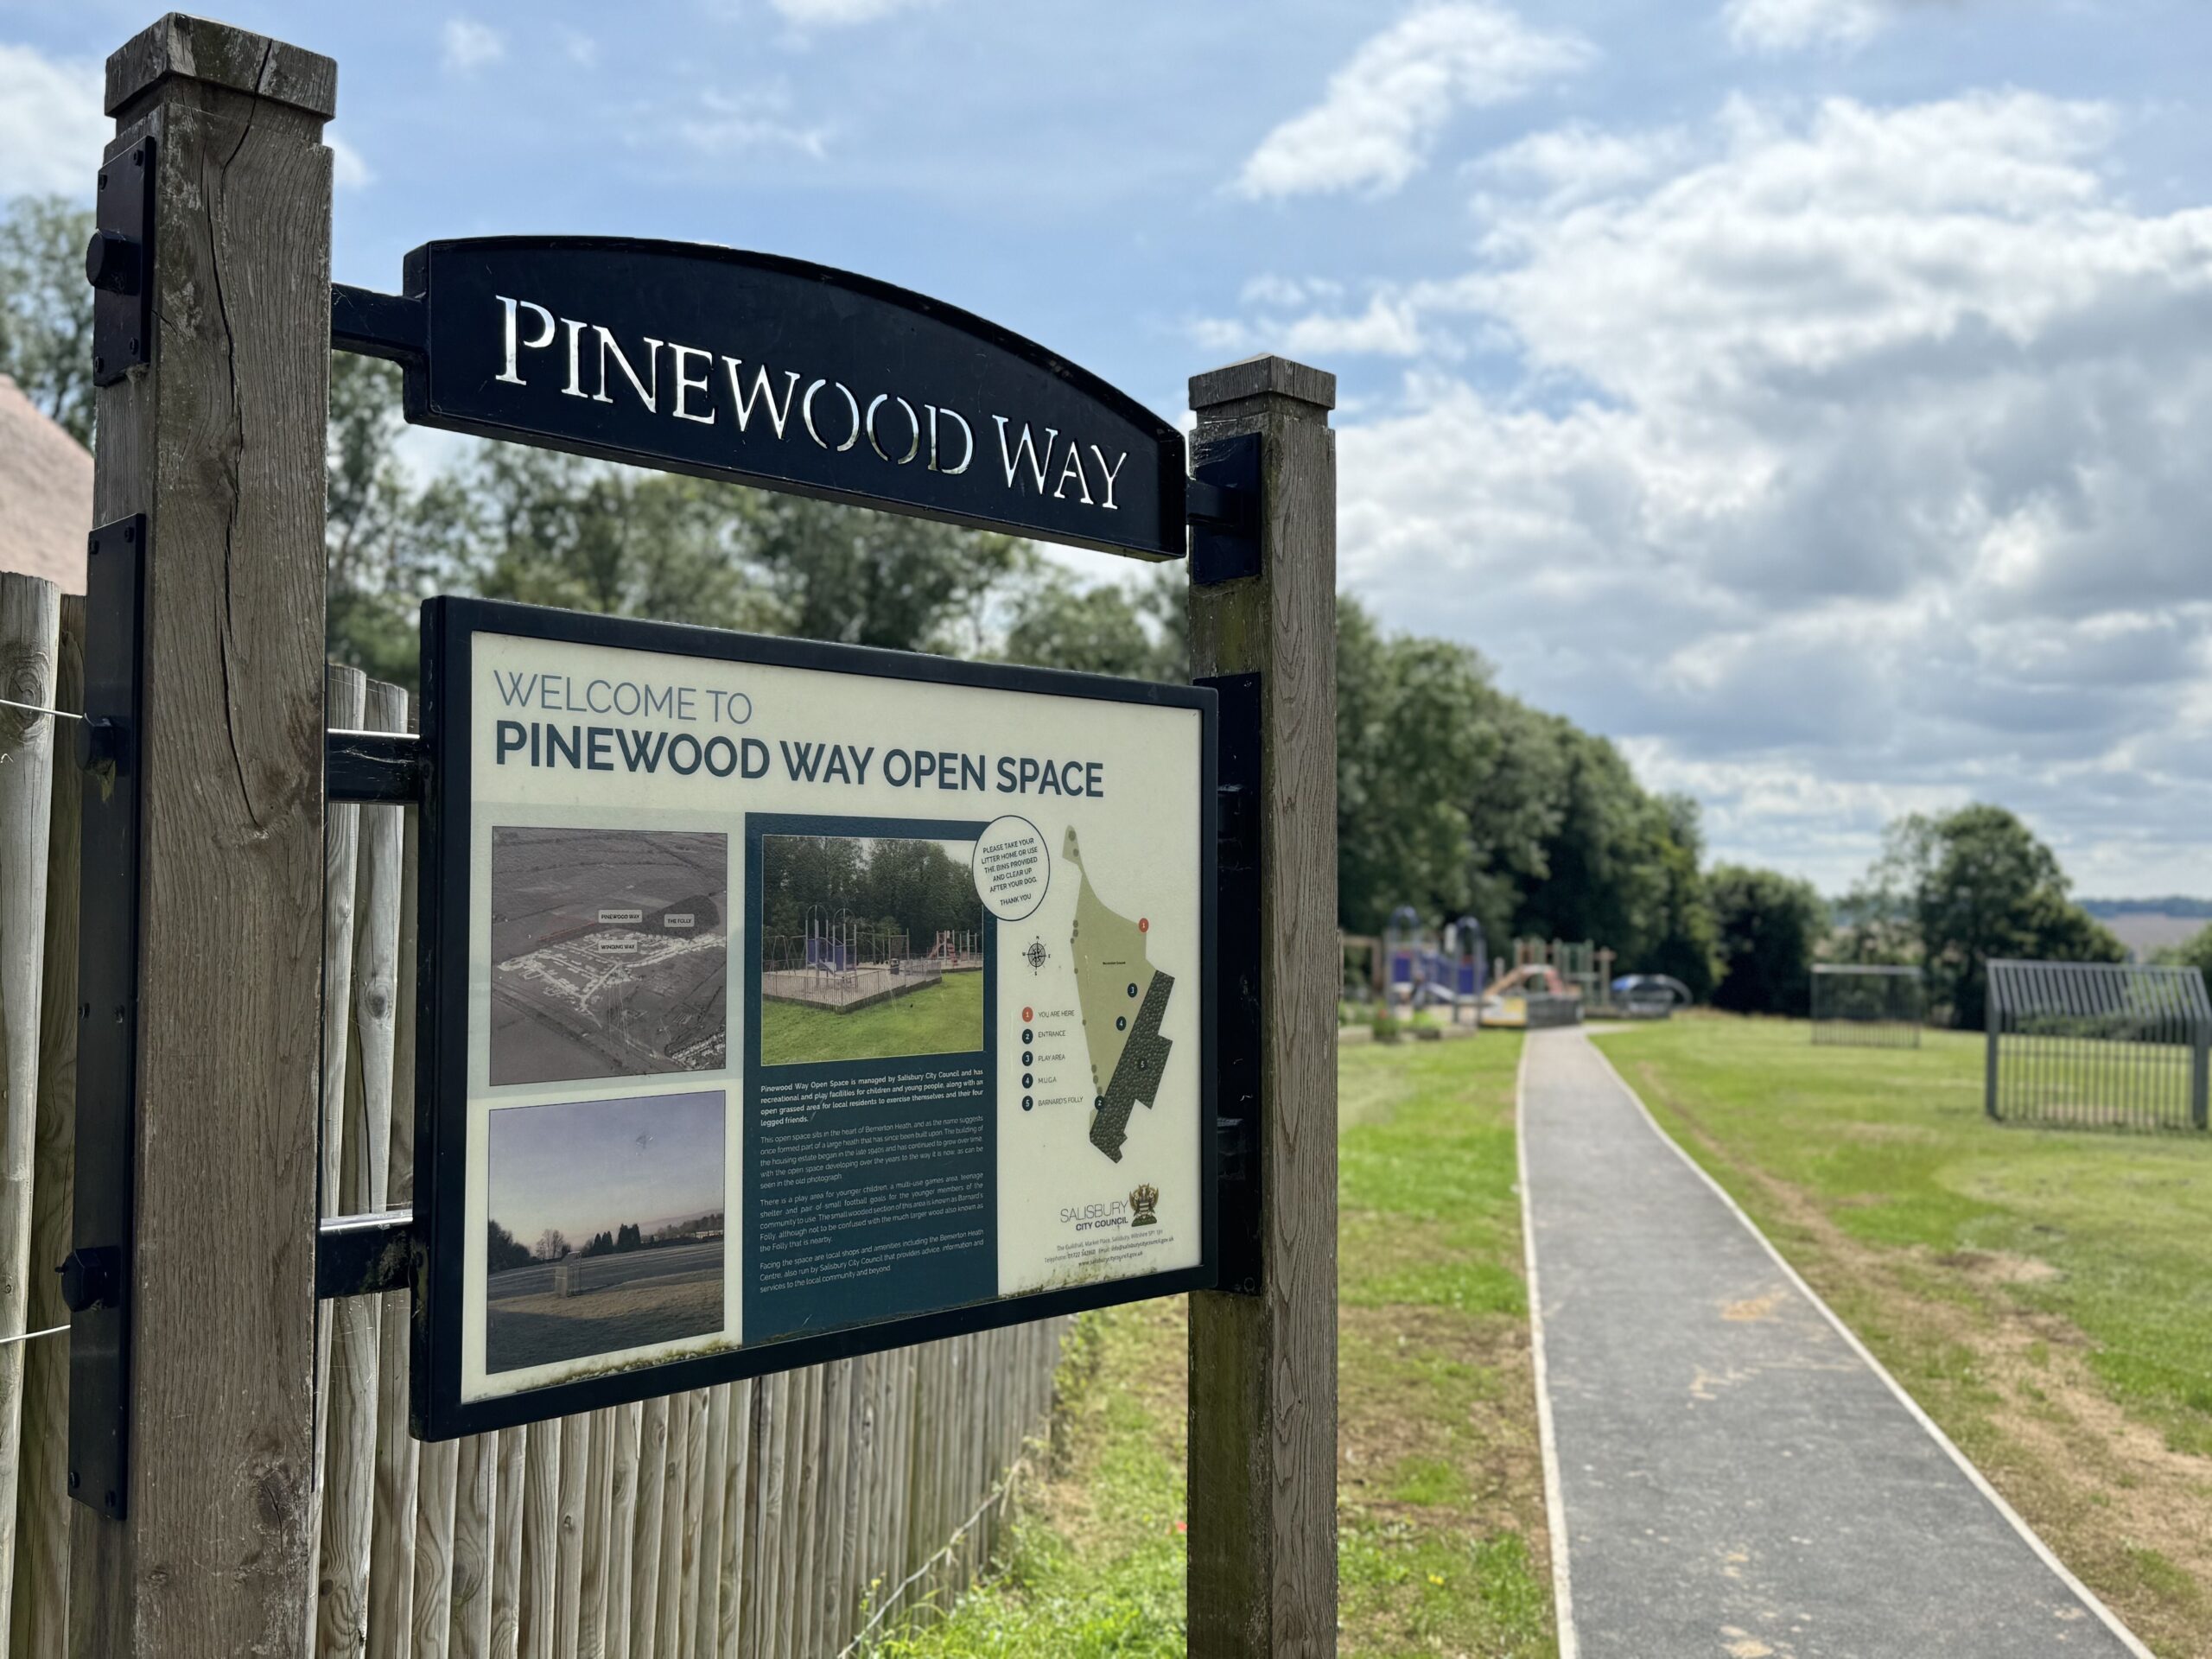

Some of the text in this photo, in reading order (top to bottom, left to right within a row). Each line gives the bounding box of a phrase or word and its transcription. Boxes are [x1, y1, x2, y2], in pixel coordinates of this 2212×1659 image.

[496, 296, 1127, 510] PINEWOOD WAY
[493, 670, 753, 724] WELCOME TO
[497, 720, 1104, 798] PINEWOOD WAY OPEN SPACE
[983, 844, 1003, 854] PLEASE
[1004, 841, 1018, 849] TAKE
[982, 854, 1001, 864] LITTER
[1001, 851, 1017, 860] HOME
[984, 857, 1038, 874] THE BINS PROVIDED
[993, 873, 1005, 882] AND
[1006, 869, 1023, 879] CLEAR
[990, 883, 1007, 893] AFTER
[1008, 880, 1023, 888] YOUR
[1000, 897, 1019, 906] THANK
[761, 1084, 792, 1092] Pinewood
[858, 1075, 887, 1085] managed
[898, 1073, 924, 1082] Salisbury
[760, 1095, 799, 1103] recreational
[867, 1085, 891, 1094] children
[779, 1105, 804, 1115] grassed
[912, 1092, 944, 1101] themselves
[761, 1117, 784, 1127] legged
[959, 1116, 983, 1124] suggests
[1060, 1199, 1128, 1223] SALISBURY
[1076, 1217, 1128, 1231] CITY COUNCIL
[760, 1261, 780, 1269] Facing
[842, 1249, 860, 1257] shops
[874, 1242, 900, 1251] amenities
[903, 1237, 928, 1246] including
[772, 1242, 788, 1250] Folly
[820, 1262, 847, 1271] Salisbury
[861, 1254, 883, 1264] Council
[897, 1249, 920, 1260] provides
[943, 1242, 973, 1251] information
[760, 1284, 785, 1293] services
[806, 1276, 822, 1285] local
[822, 1271, 855, 1282] community
